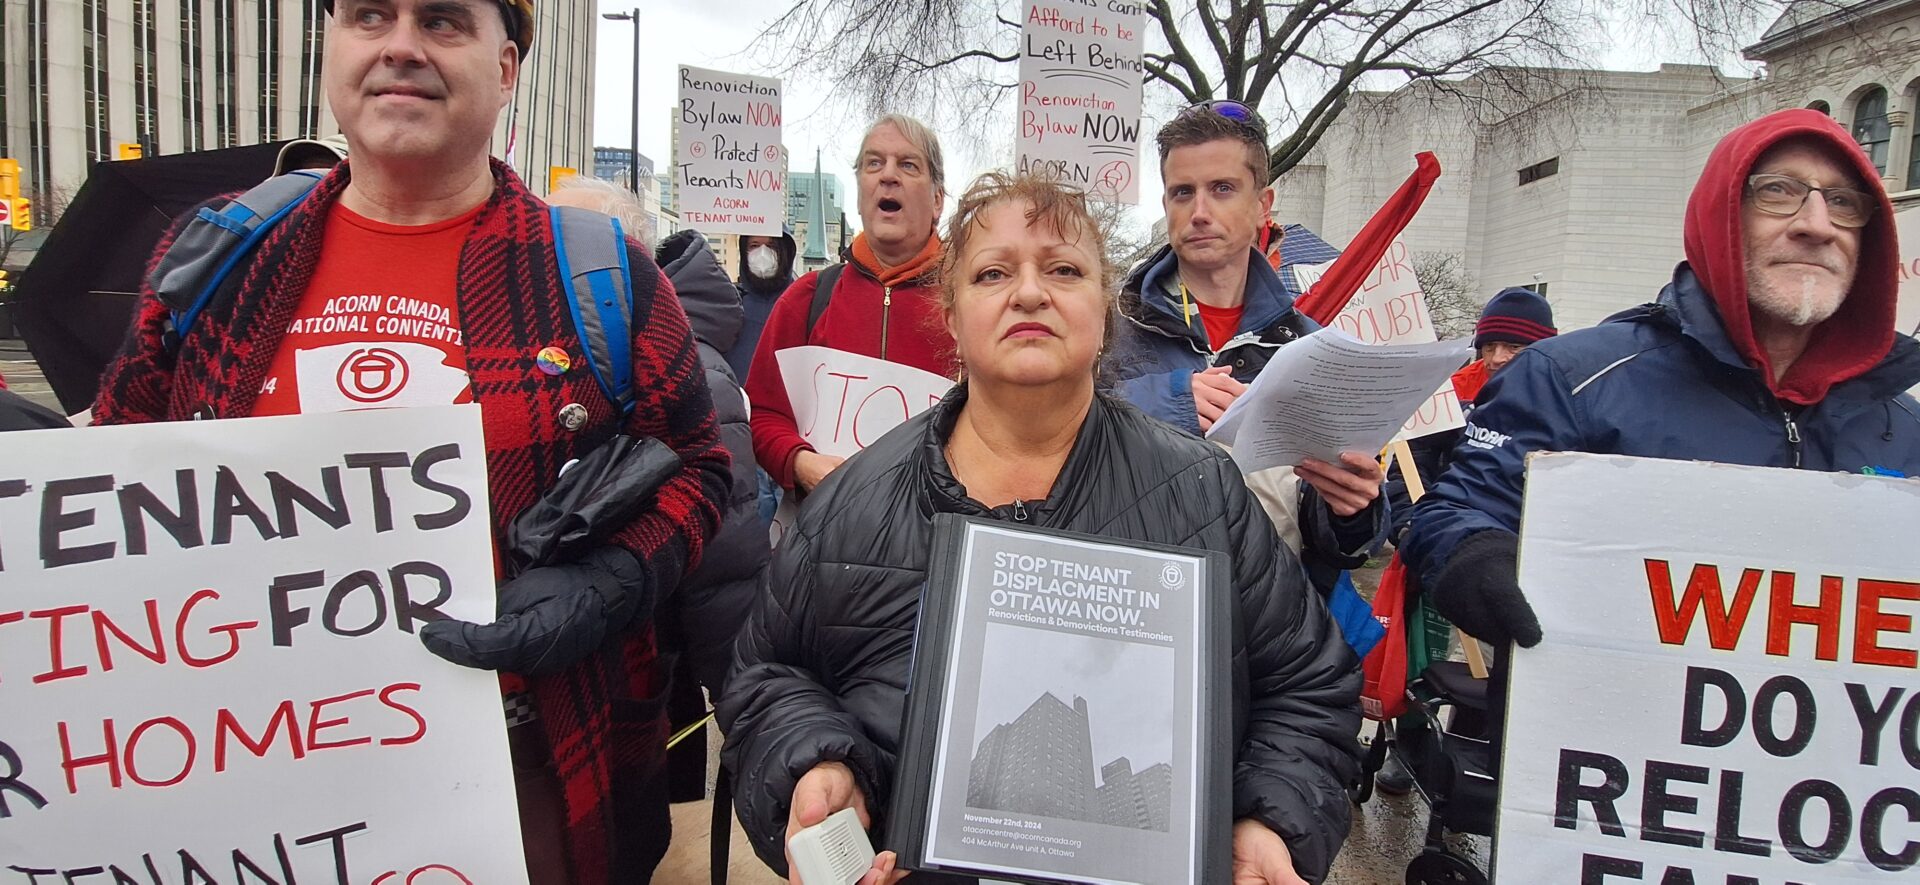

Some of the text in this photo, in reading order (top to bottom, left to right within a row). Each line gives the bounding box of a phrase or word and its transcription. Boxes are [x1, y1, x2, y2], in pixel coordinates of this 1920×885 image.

[1028, 5, 1134, 41] Afford to be
[1027, 34, 1142, 73] Left Behind
[680, 68, 778, 97] Renoviction
[1023, 80, 1115, 111] Renoviction
[682, 98, 782, 131] Bylaw NOW
[1022, 110, 1141, 143] Bylaw NOW
[711, 134, 760, 163] Protect
[680, 163, 782, 192] Tenants NOW
[1018, 154, 1090, 184] ACORN
[684, 212, 765, 224] TENANT UNION
[713, 197, 749, 209] ACORN
[286, 315, 369, 334] ATIONAL
[322, 295, 450, 325] ACORN CANADA
[1338, 290, 1425, 345] DOUBT
[1403, 389, 1455, 431] UT
[994, 551, 1047, 574] STOP
[1051, 559, 1132, 586] TENANT
[268, 560, 453, 647] FOR
[992, 570, 1136, 606] DISPLACMENT
[1139, 591, 1160, 610] IN
[988, 607, 1174, 643] Renovictions & Demovictions Testimonies
[990, 589, 1146, 628] OTTAWA NOW.
[1680, 665, 1817, 758] DO
[57, 683, 427, 795] HOMES
[964, 813, 1042, 830] November 22nd, 2024
[961, 836, 976, 846] 404
[976, 838, 1009, 850] McArthur
[1010, 843, 1024, 852] Ave
[1025, 844, 1039, 854] unit
[1048, 847, 1075, 858] Ottawa
